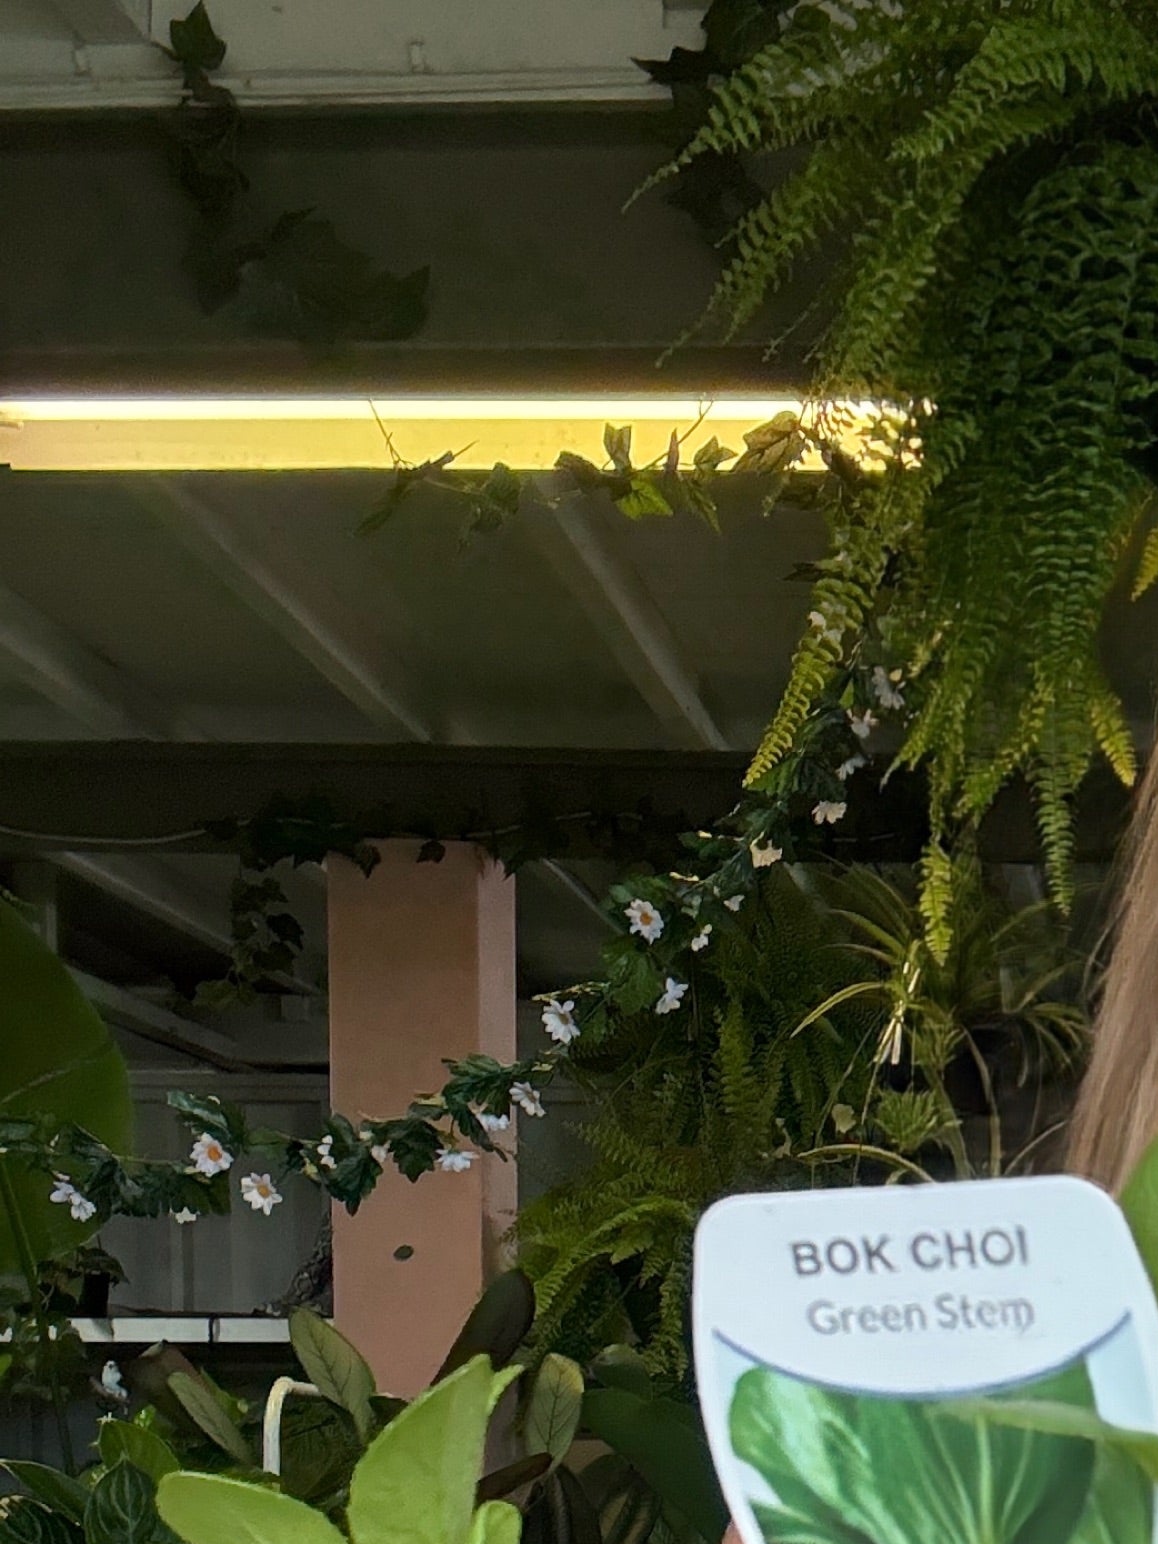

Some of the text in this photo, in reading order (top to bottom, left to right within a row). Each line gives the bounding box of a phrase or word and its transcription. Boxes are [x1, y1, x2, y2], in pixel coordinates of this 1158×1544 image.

[791, 1226, 1029, 1278] BOK CHOI
[806, 1292, 1034, 1335] Green Stem
